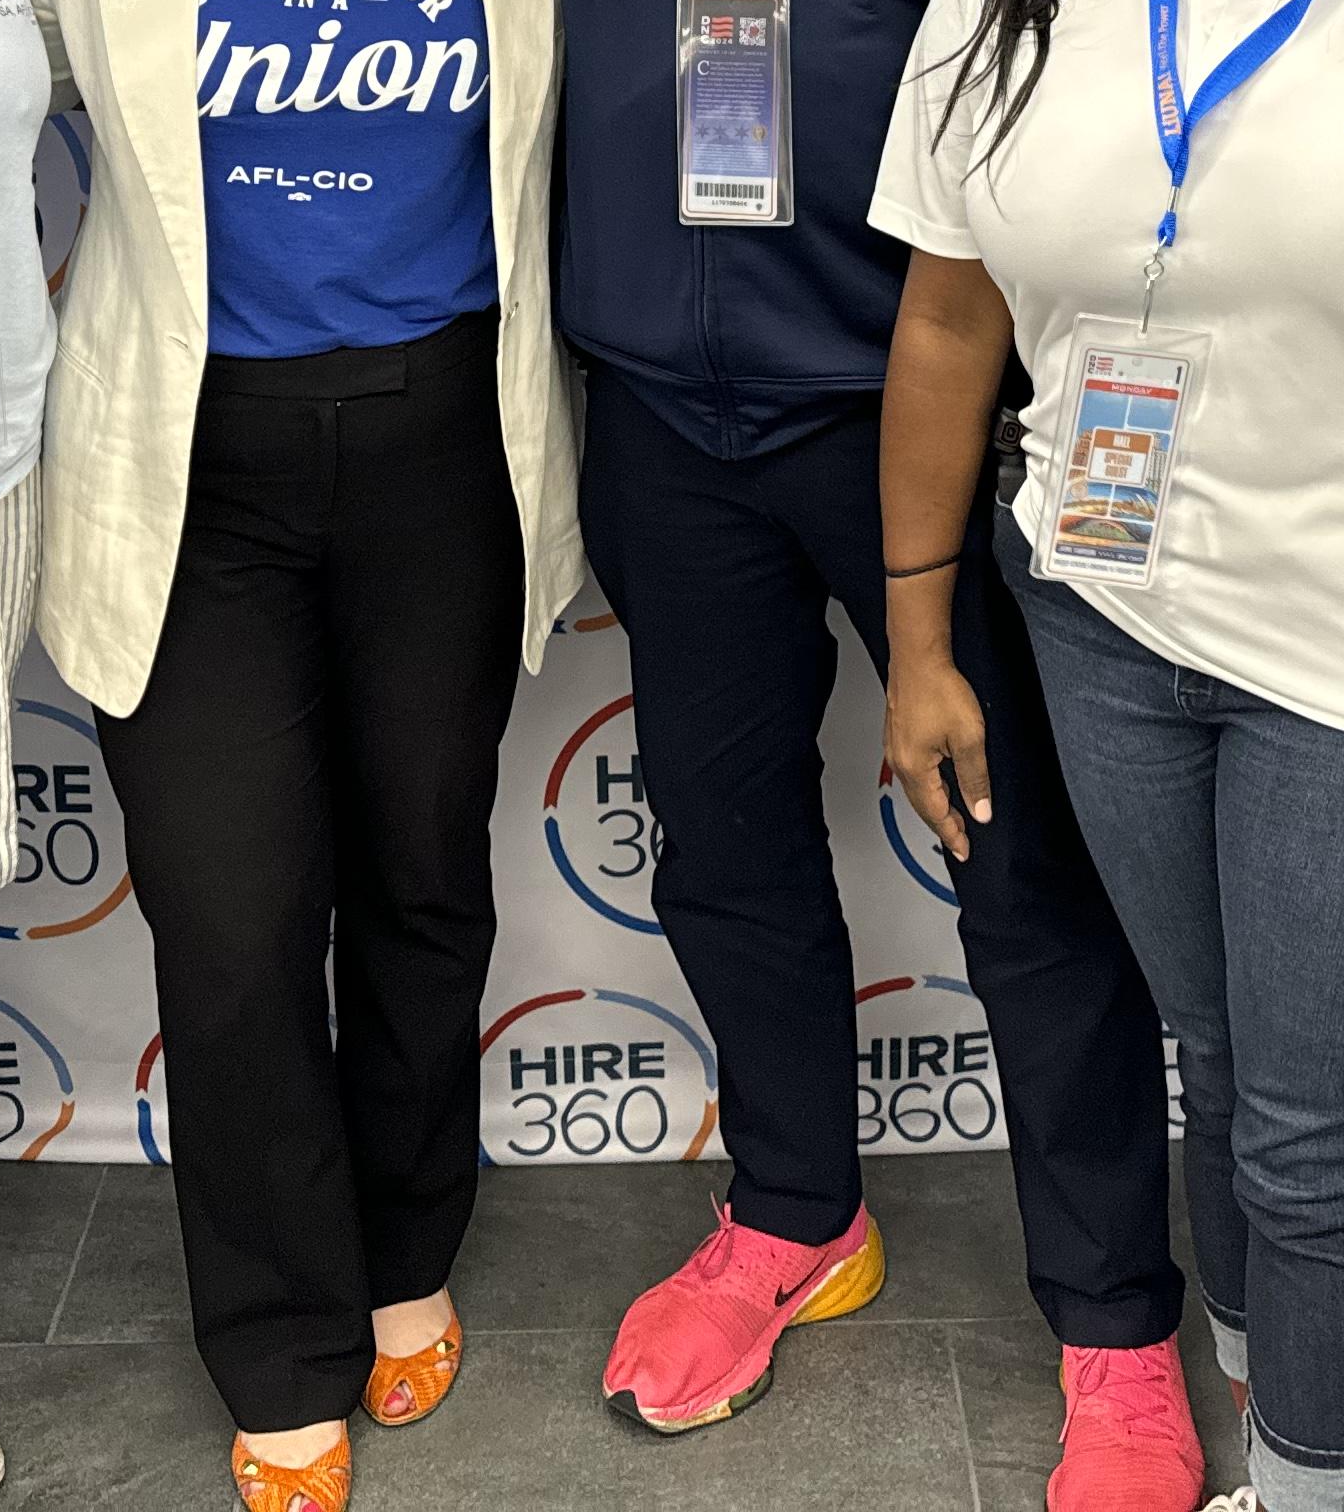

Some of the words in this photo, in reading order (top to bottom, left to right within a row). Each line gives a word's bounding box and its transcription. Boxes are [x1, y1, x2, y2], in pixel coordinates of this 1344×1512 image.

[226, 165, 374, 192] AFL-CIO
[14, 765, 93, 814] RE
[14, 818, 99, 886] 60
[510, 1041, 666, 1089] HIRE
[857, 1031, 989, 1081] HIRE
[507, 1085, 668, 1157] 360
[857, 1078, 996, 1144] 360
